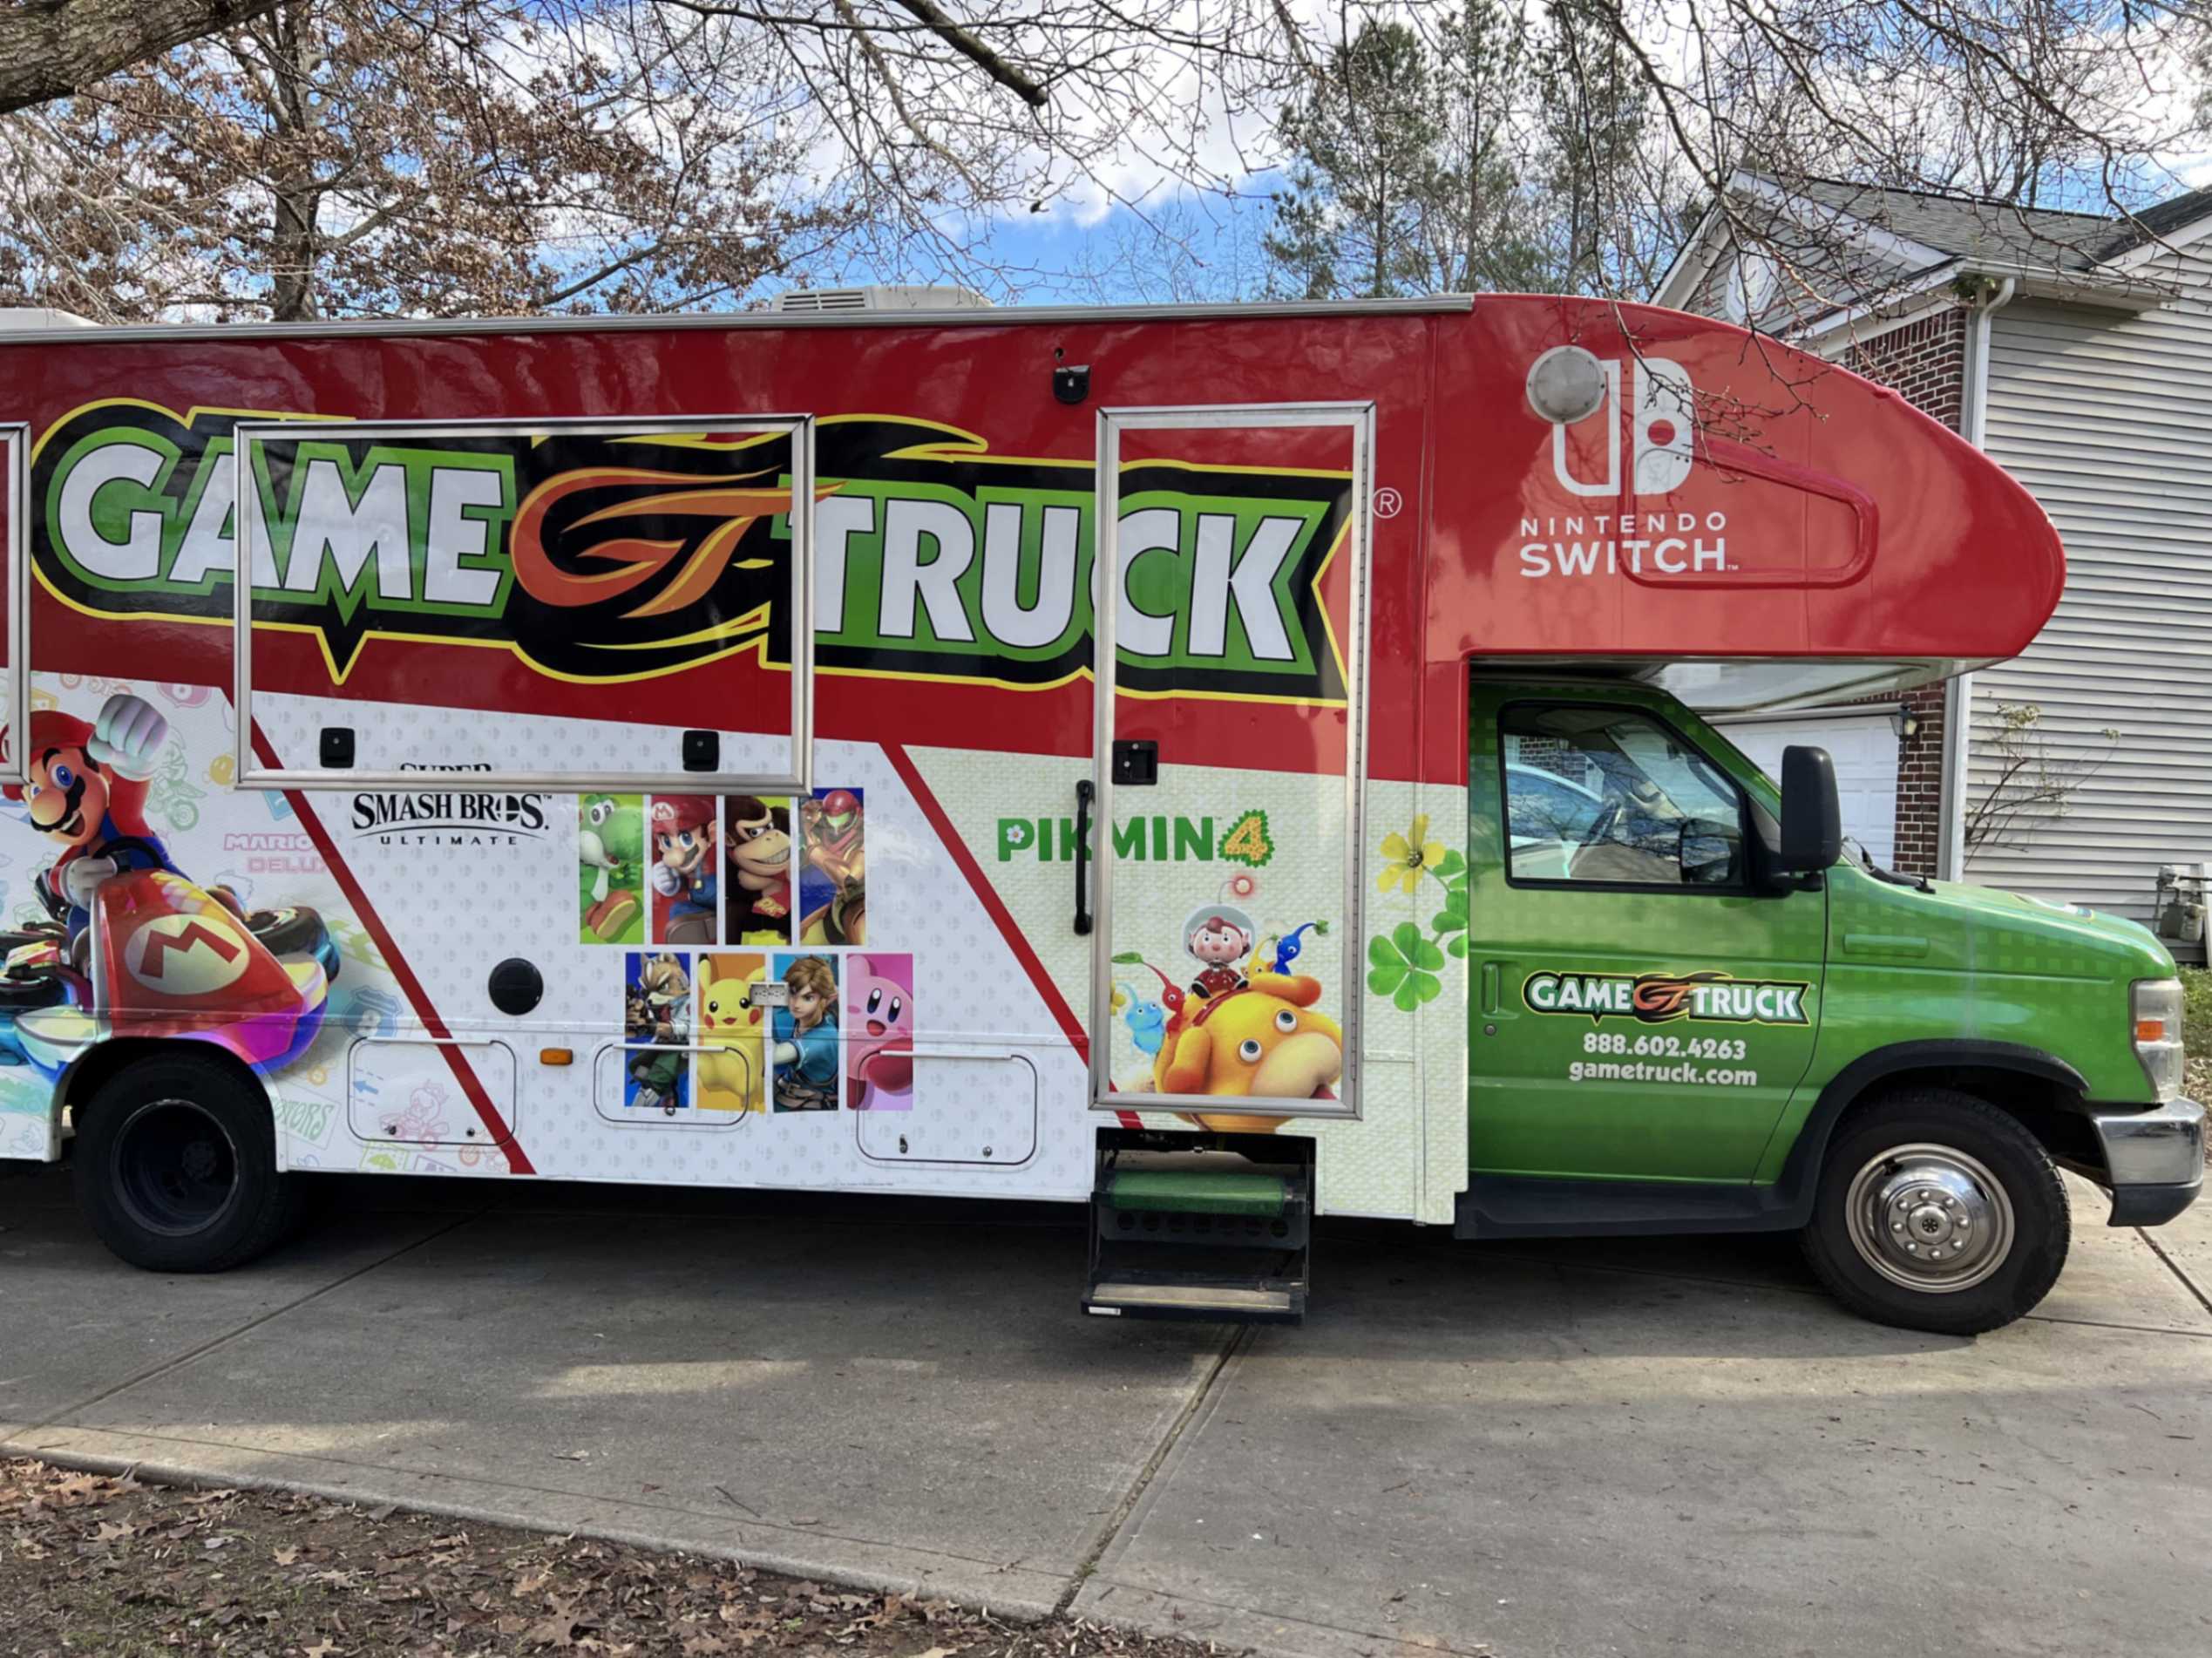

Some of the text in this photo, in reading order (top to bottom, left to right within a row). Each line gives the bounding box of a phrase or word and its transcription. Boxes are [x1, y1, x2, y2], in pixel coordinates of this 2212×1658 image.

[1520, 511, 1727, 537] NINTENDO
[58, 443, 504, 606] GAME
[788, 495, 1310, 662] TRUCK
[1519, 537, 1727, 577] SWITCH
[351, 792, 452, 830] SMASH
[223, 833, 315, 852] MARIO
[380, 835, 518, 846] ULTIMATE
[997, 812, 1272, 866] PIKMIN 4
[1530, 979, 1632, 1011] GAME
[1691, 986, 1799, 1018] TRUCK
[1583, 1032, 1747, 1060] 888.602.4263
[1568, 1060, 1758, 1086] gametruck.com
